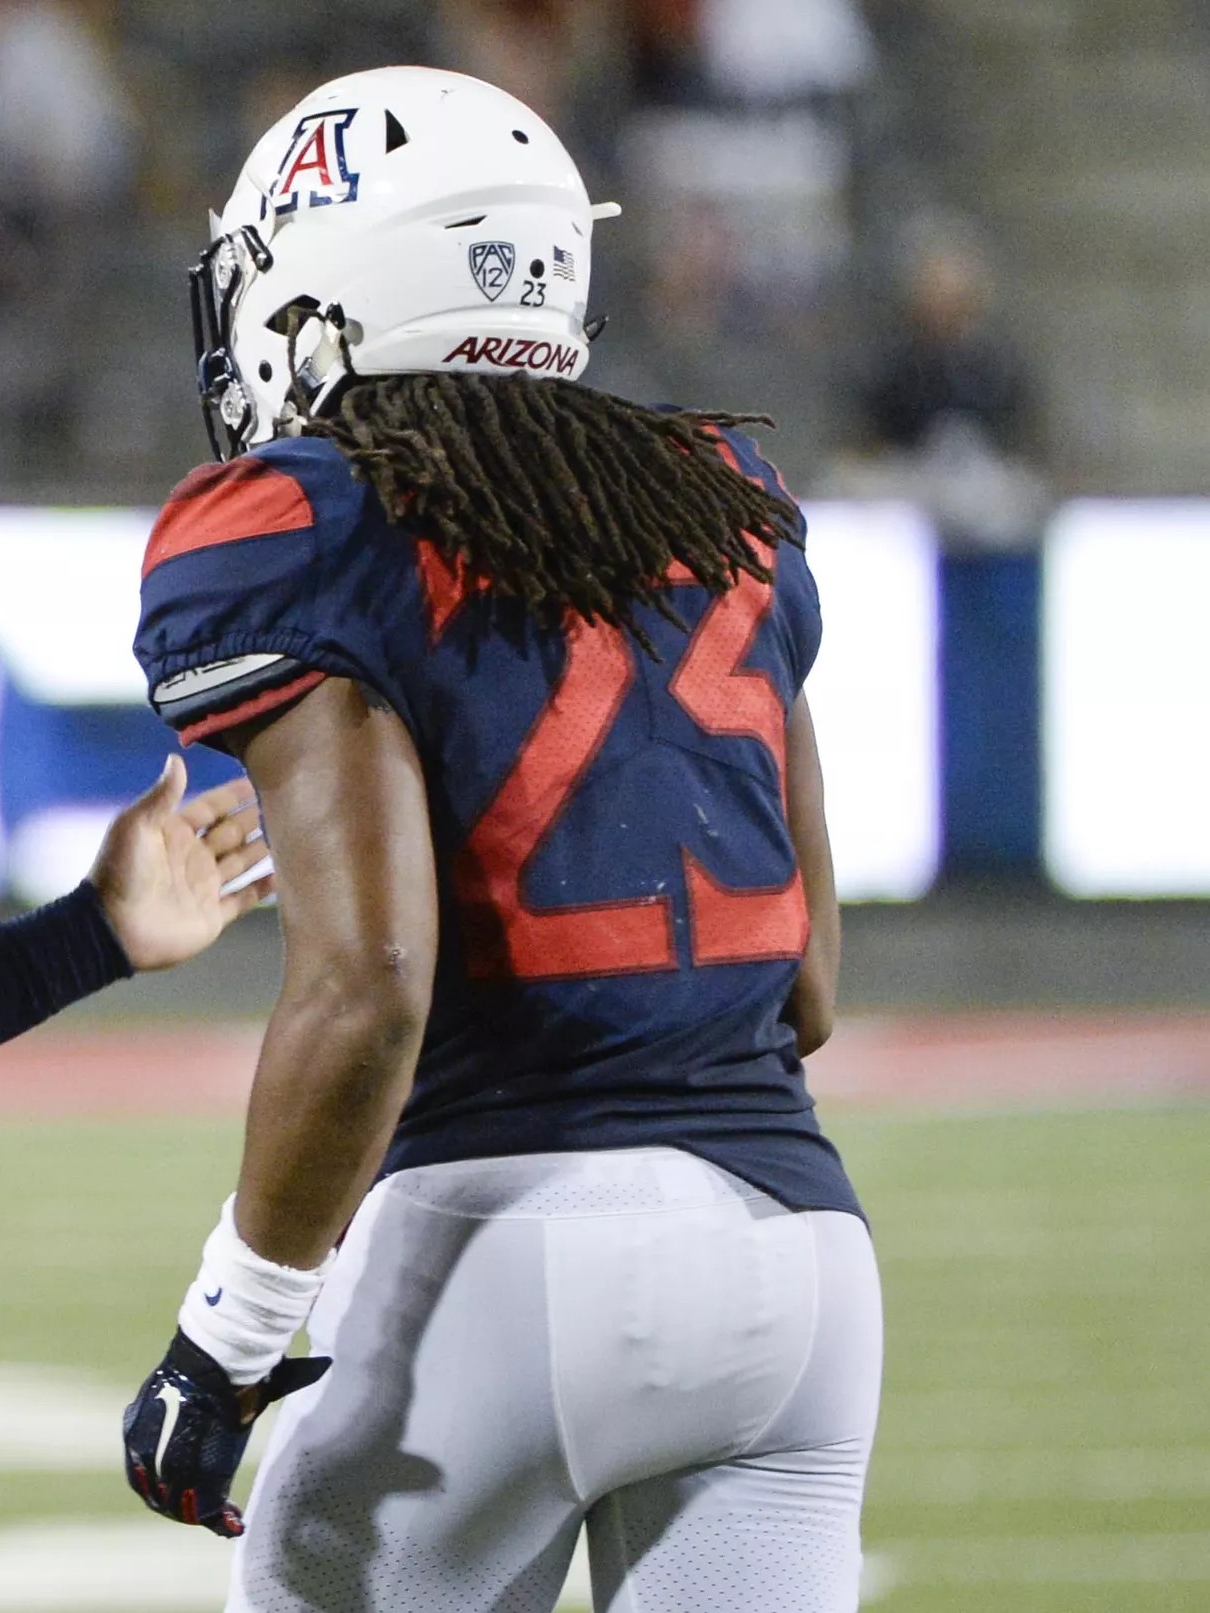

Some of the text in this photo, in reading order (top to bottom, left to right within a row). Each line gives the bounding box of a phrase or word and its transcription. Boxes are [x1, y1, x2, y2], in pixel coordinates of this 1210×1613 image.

[260, 108, 359, 220] A
[472, 244, 512, 276] PAC
[482, 267, 504, 288] 12
[520, 280, 547, 307] 23
[441, 336, 580, 375] ARIZONA
[412, 500, 811, 982] 23
